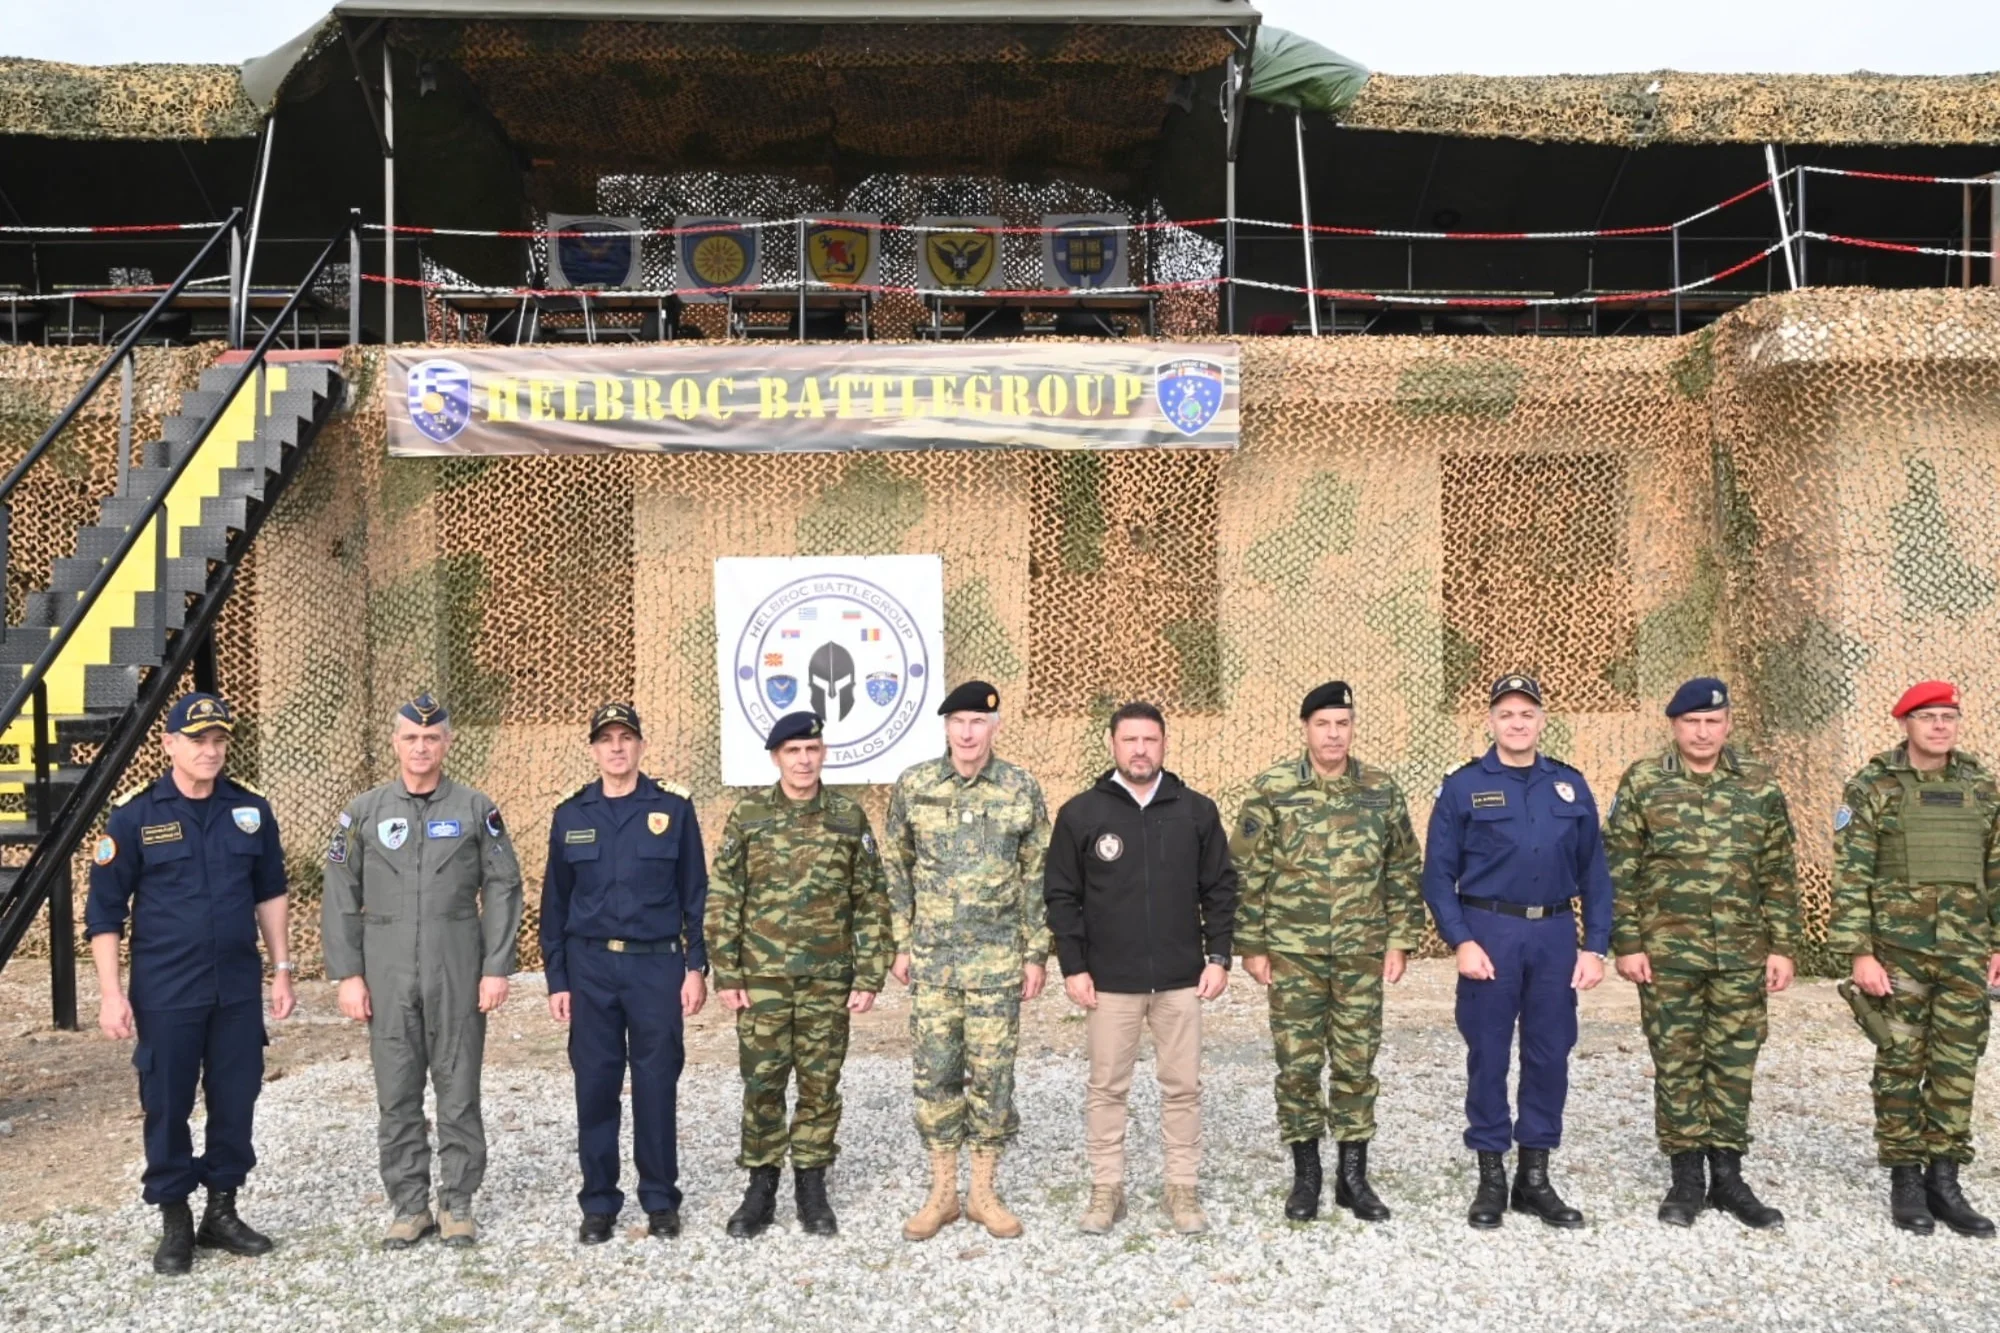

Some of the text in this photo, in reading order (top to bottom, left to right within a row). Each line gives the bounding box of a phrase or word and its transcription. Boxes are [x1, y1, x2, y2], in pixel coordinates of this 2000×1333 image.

[486, 373, 1144, 423] HELBROC BATTLEGROUP
[749, 581, 914, 640] HELBROC BATTLEGROUP
[832, 737, 885, 762] TALOS
[887, 699, 918, 740] 2022
